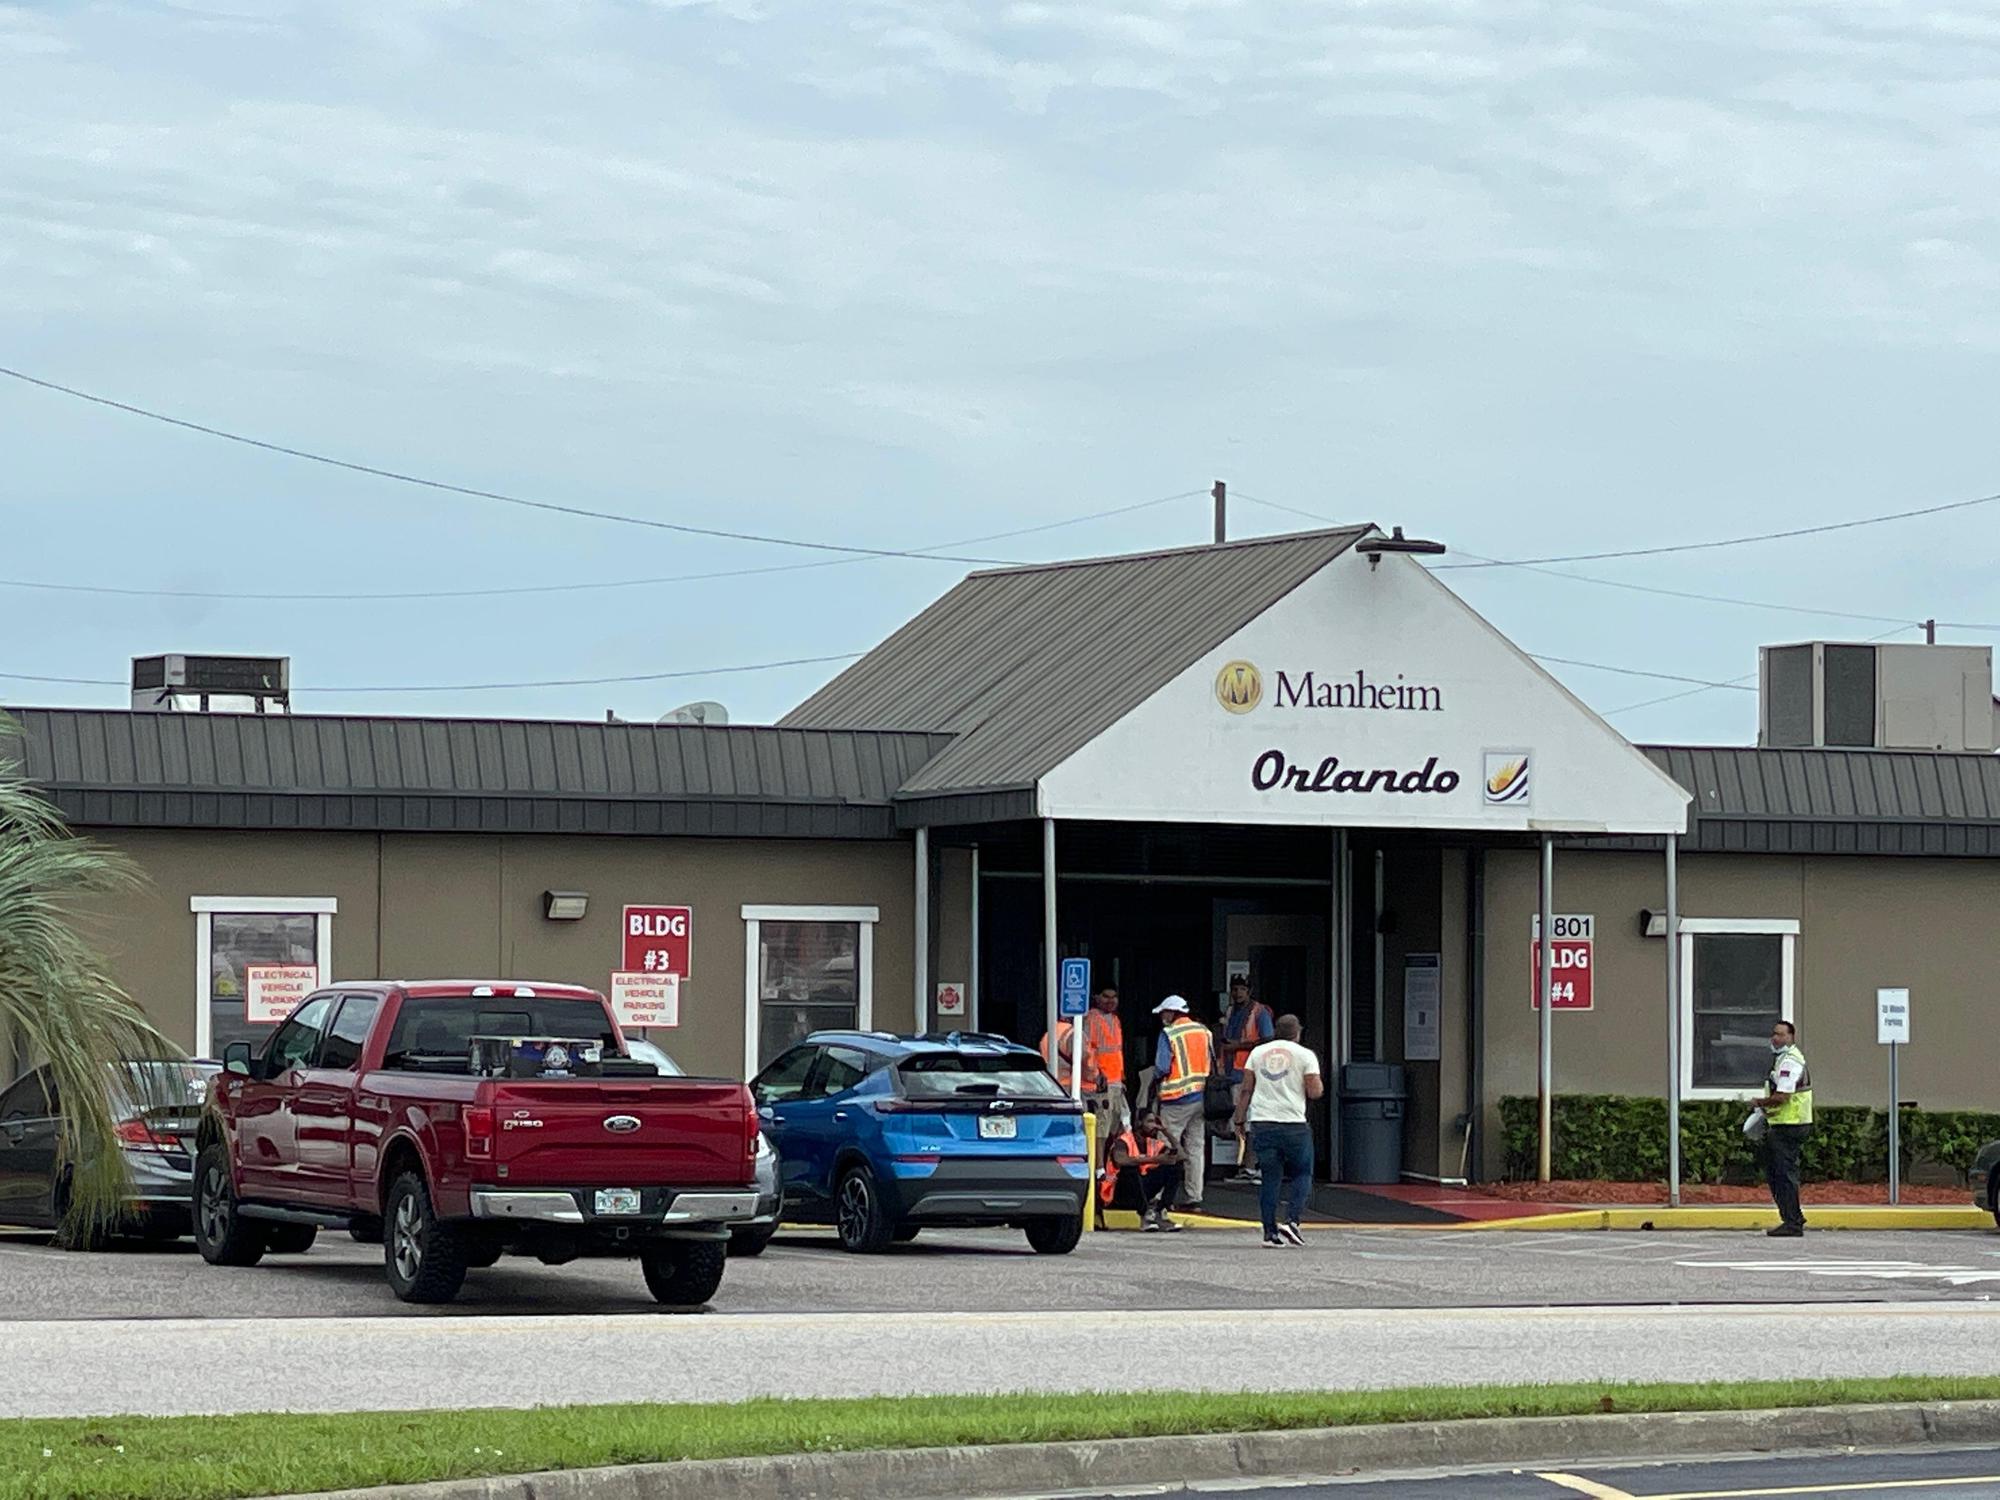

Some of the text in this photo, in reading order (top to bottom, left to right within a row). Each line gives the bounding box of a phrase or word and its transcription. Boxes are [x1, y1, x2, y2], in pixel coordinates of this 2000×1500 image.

[1274, 670, 1444, 711] Manheim
[1252, 750, 1460, 793] Orlando
[629, 914, 686, 937] BLDG
[1535, 917, 1590, 937] 801
[643, 950, 669, 971] #3
[1537, 948, 1588, 969] LDG
[251, 970, 313, 979] ELECTRICAL
[615, 977, 675, 986] ELECTRICAL
[260, 983, 303, 992] VEHICLE
[624, 989, 665, 998] VEHICLE
[1551, 981, 1575, 1002] #4
[623, 1001, 666, 1010] PARKING
[631, 1013, 657, 1022] ONLY
